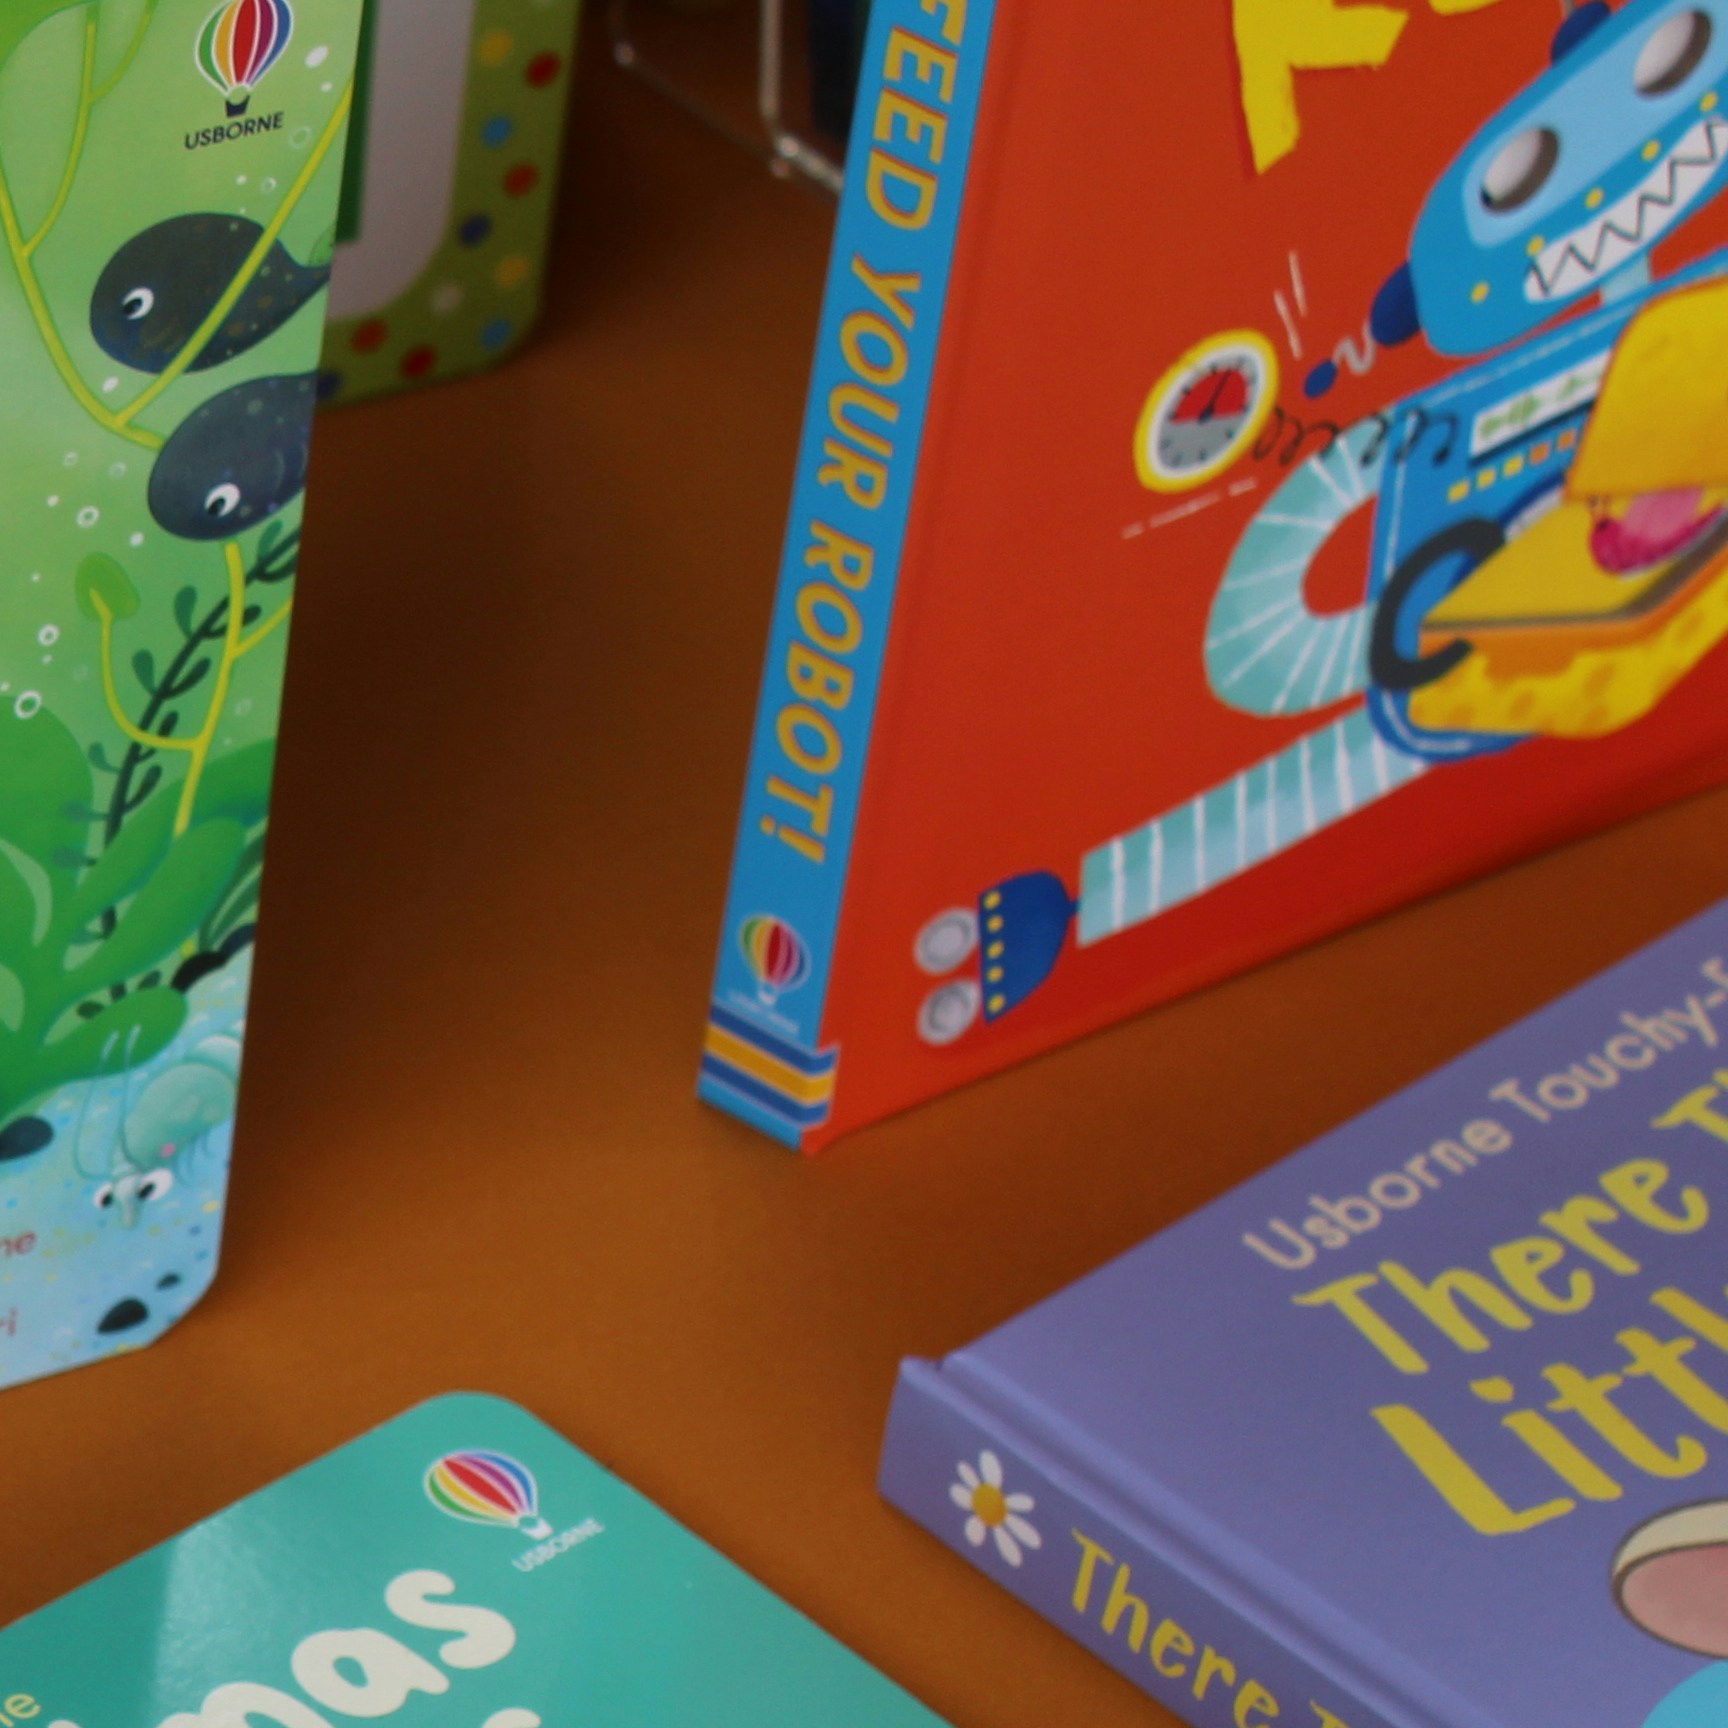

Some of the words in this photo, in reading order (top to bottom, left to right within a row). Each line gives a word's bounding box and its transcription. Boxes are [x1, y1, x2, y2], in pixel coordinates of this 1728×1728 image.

[183, 110, 285, 151] USBORNE
[817, 251, 922, 509] YOUR
[758, 520, 875, 863] ROBOT!
[1242, 1119, 1514, 1270] Usborne
[1291, 1158, 1709, 1375] There
